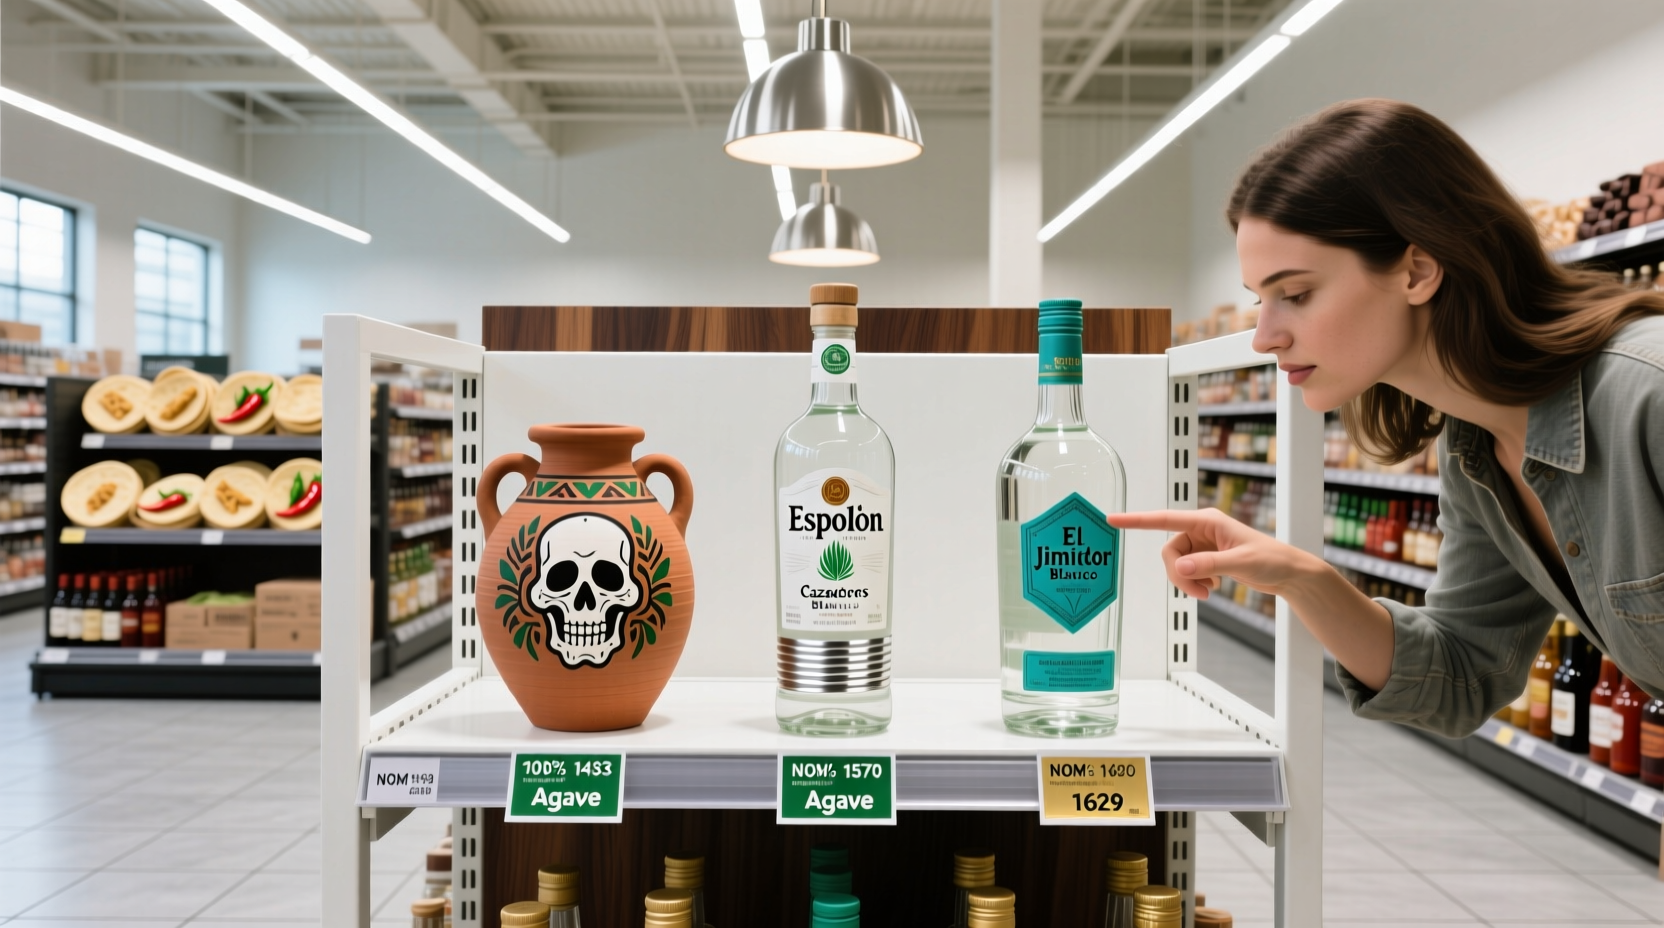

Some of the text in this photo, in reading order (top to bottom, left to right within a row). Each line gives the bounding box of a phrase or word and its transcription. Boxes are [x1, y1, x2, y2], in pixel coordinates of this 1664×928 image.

[1062, 526, 1085, 546] El
[376, 773, 409, 786] NOM
[843, 763, 882, 778] 1570
[531, 787, 602, 813] Agave
[804, 790, 874, 816] Agave
[1072, 792, 1124, 811] 1629
